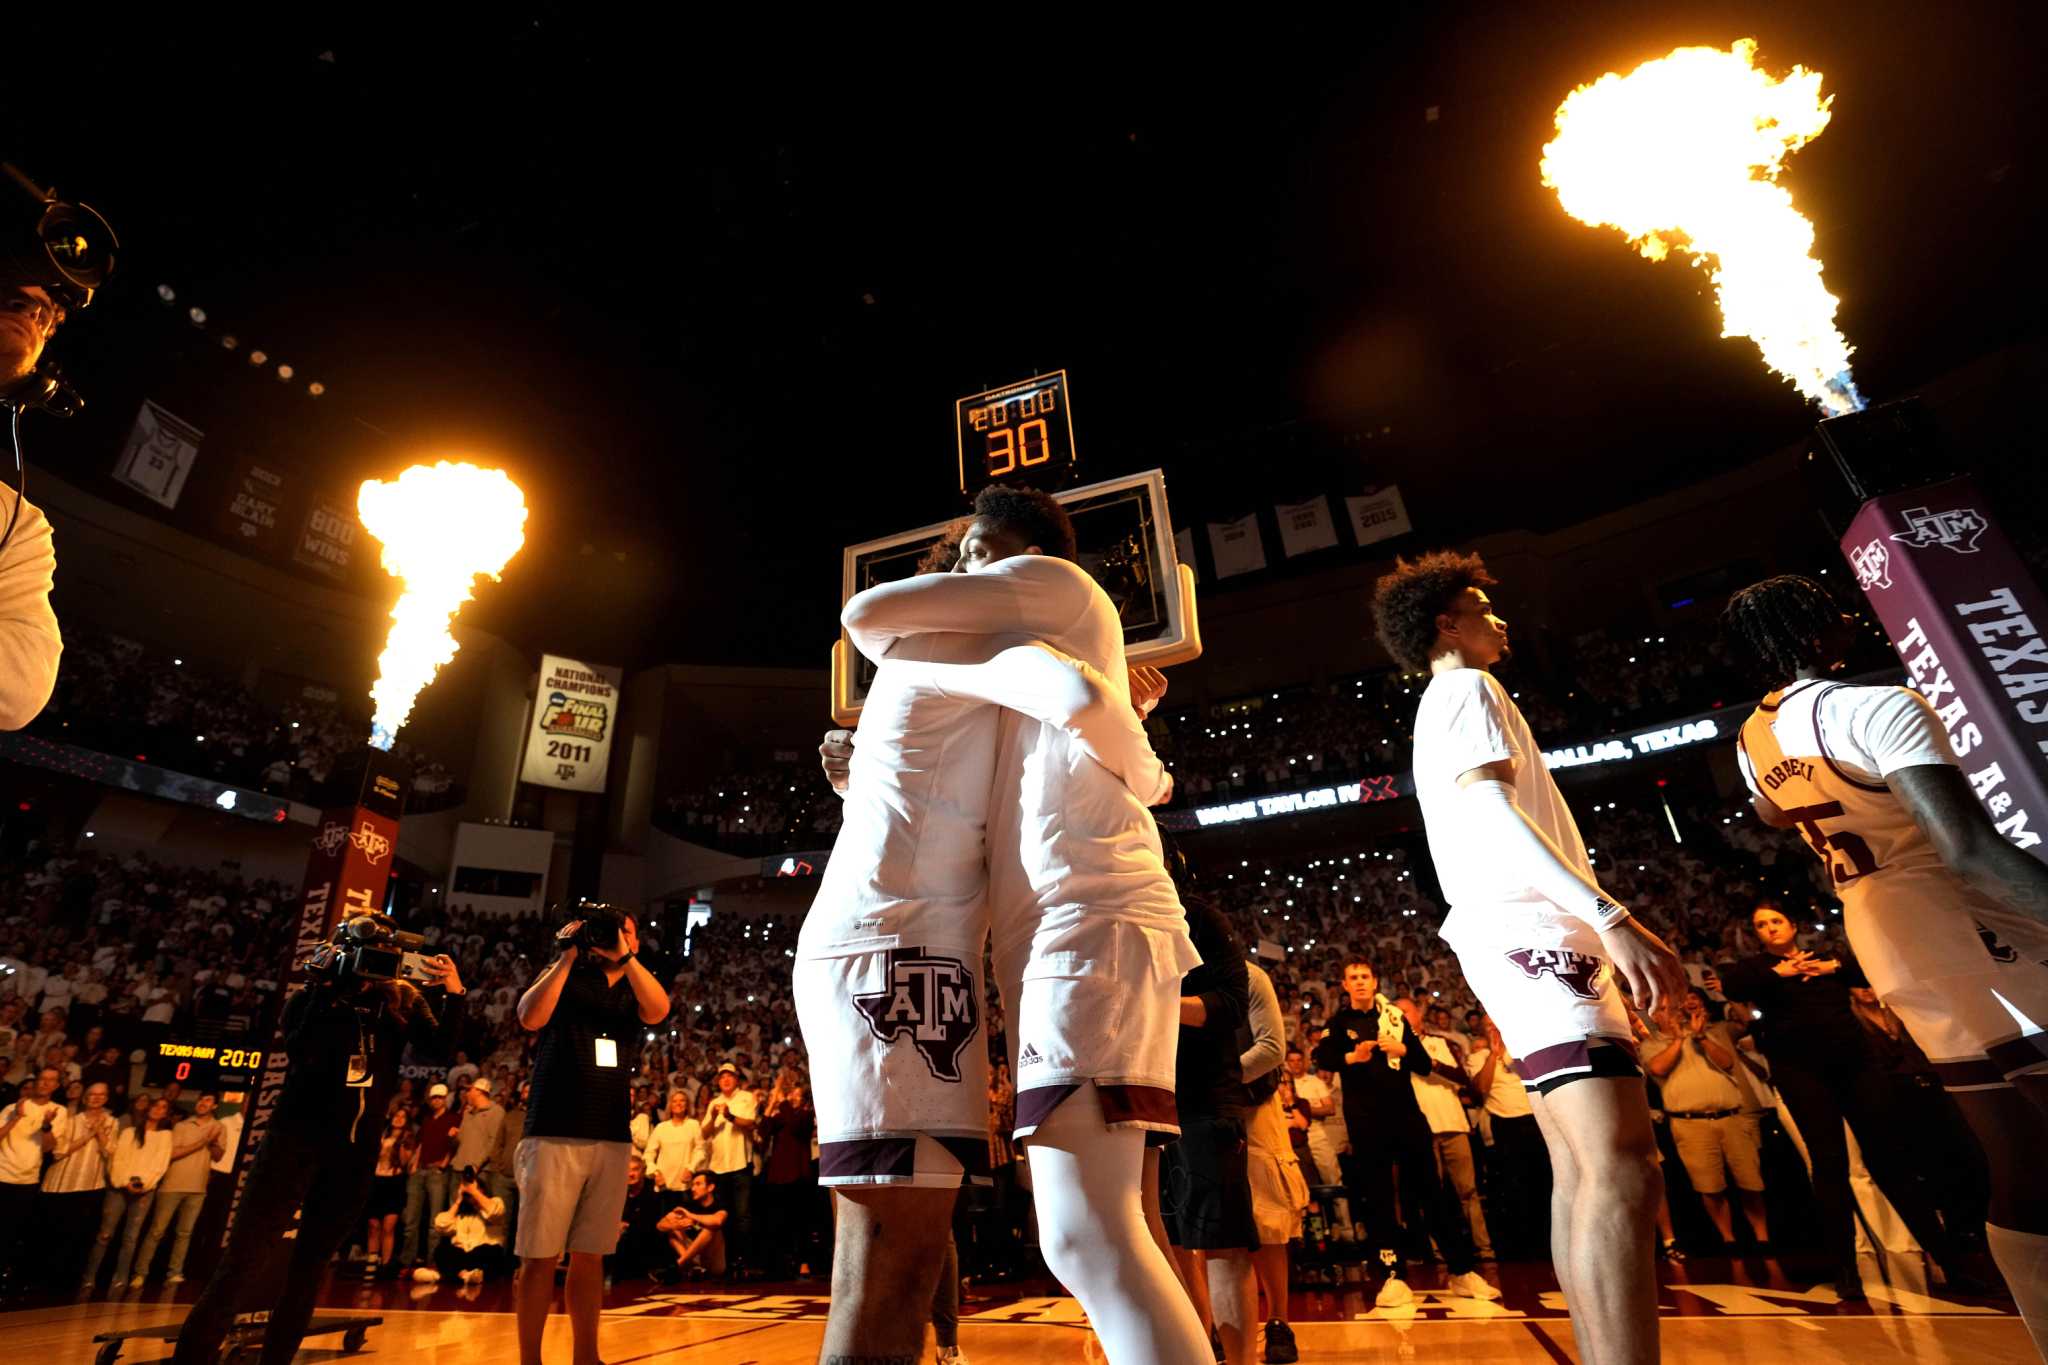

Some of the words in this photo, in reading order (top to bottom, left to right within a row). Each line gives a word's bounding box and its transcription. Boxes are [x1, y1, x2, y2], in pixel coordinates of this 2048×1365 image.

[987, 418, 1050, 476] 30
[310, 510, 353, 545] 800
[304, 534, 350, 566] WINS
[555, 667, 606, 684] NATIONAL
[546, 678, 611, 697] CHAMPIONS
[563, 699, 604, 717] FINAL
[1631, 719, 1719, 753] TEXAS
[1898, 617, 1982, 757] TEXAS
[1968, 762, 2042, 850] A&M
[546, 740, 591, 763] 2011
[1257, 787, 1336, 816] TAYLOR
[160, 1043, 193, 1058] TEXAS
[219, 1049, 261, 1069] 20:0
[175, 1062, 191, 1080] 0
[398, 1063, 448, 1079] PORTS
